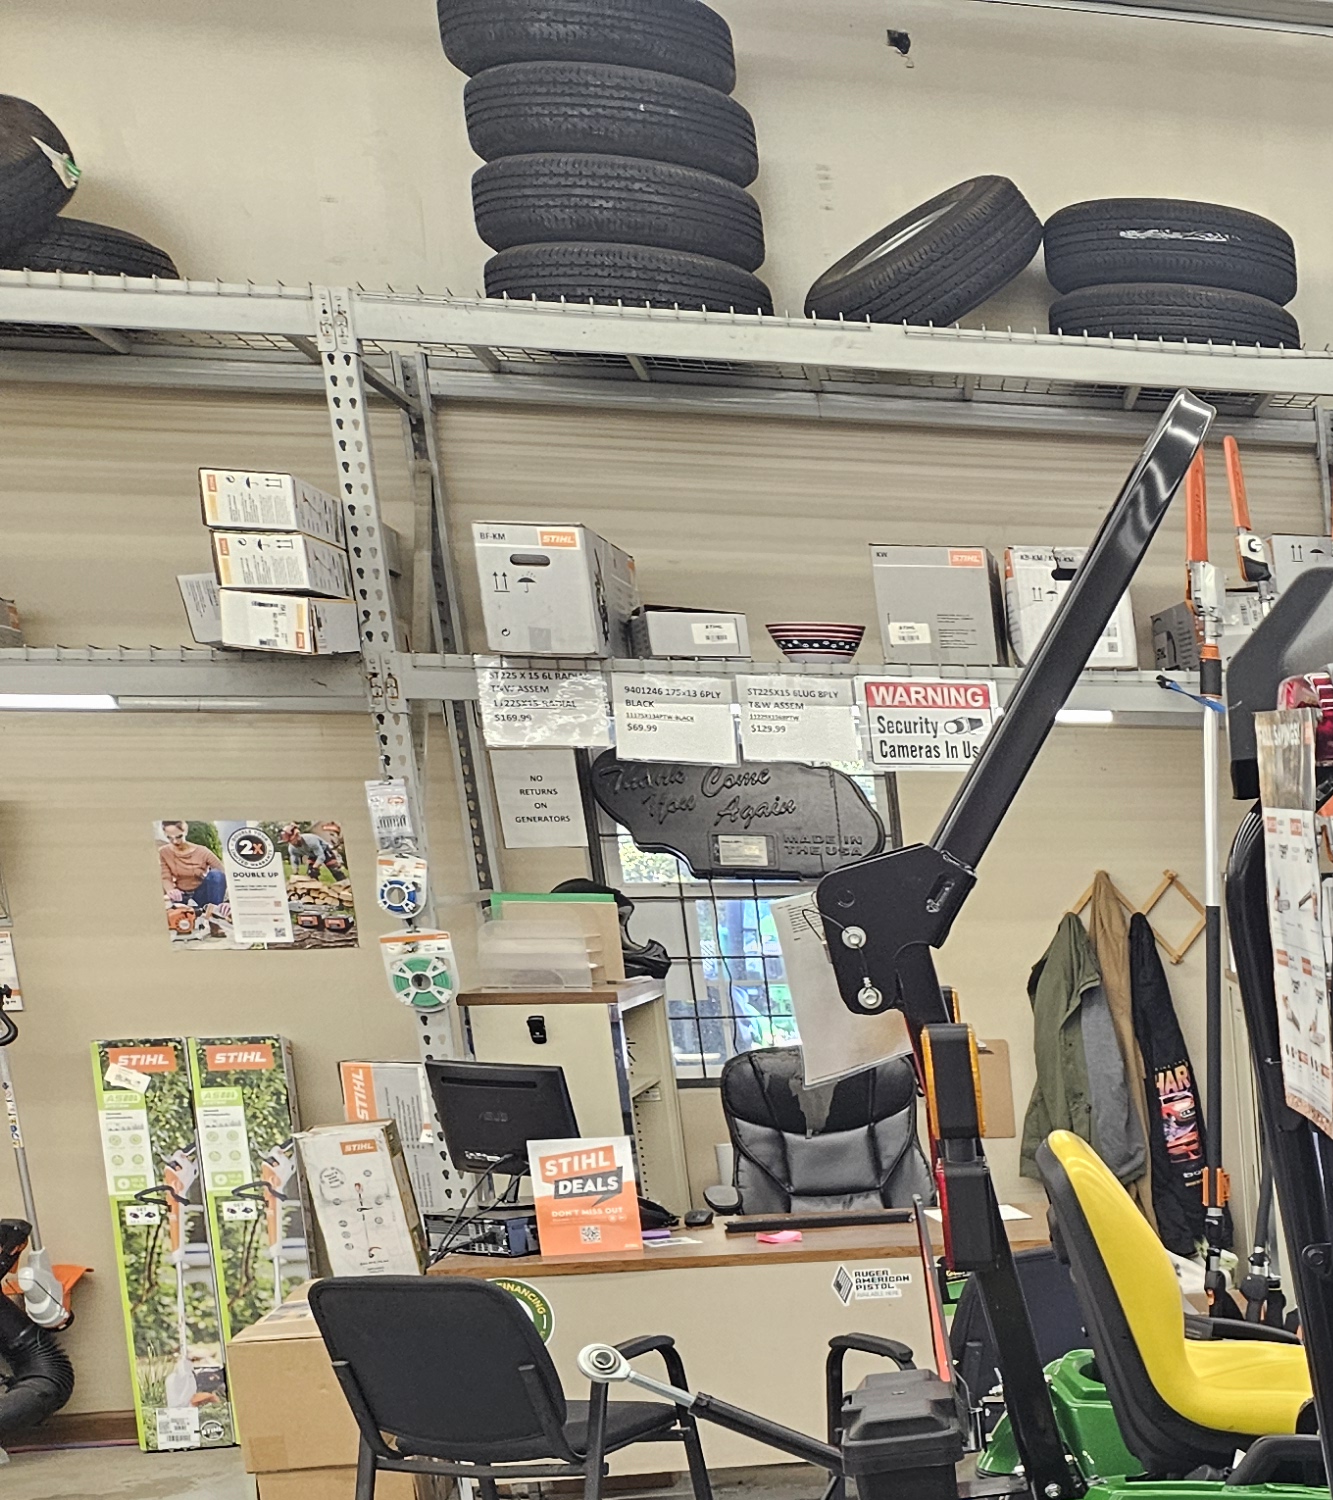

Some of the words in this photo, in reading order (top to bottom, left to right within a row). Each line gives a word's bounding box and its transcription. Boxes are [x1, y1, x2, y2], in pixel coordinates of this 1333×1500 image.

[480, 533, 506, 541] BF-KM
[542, 534, 576, 545] STIHL
[952, 553, 981, 564] STIHL
[528, 672, 540, 680] 15
[517, 684, 549, 693] ASSEM
[624, 685, 663, 696] 9401246
[700, 689, 721, 699] 6PLY
[870, 685, 984, 707] WARNING
[626, 699, 655, 708] BLACK
[748, 701, 772, 710] T&W
[773, 701, 804, 711] ASSEM
[494, 712, 532, 723] $169.99
[627, 722, 658, 733] $69.99
[751, 724, 786, 734] $129.99
[877, 715, 939, 739] Security
[879, 740, 941, 759] Cameras
[945, 740, 958, 759] In
[963, 742, 980, 760] Us
[529, 774, 543, 782] NO
[702, 764, 771, 800] Come
[519, 787, 558, 796] RETURNS
[534, 801, 548, 810] ON
[713, 794, 797, 830] Again
[515, 814, 571, 824] GENERATORS
[783, 835, 836, 846] MADE
[844, 835, 863, 846] IN
[783, 846, 822, 856] THE
[823, 846, 863, 857] USA
[232, 871, 265, 879] DOUBLE
[267, 871, 279, 879] UP
[116, 1054, 170, 1067] STIHL
[214, 1051, 267, 1064] STIHL
[356, 1068, 369, 1121] STIHL
[344, 1143, 374, 1152] STIHL
[544, 1150, 612, 1177] STIHL
[558, 1176, 619, 1195] DEALS
[551, 1207, 580, 1218] DON'T
[581, 1208, 603, 1216] MISS
[605, 1206, 623, 1214] OUT
[854, 1269, 889, 1277] RUGER
[856, 1275, 910, 1284] AMERICAN
[856, 1283, 895, 1291] PISTOL
